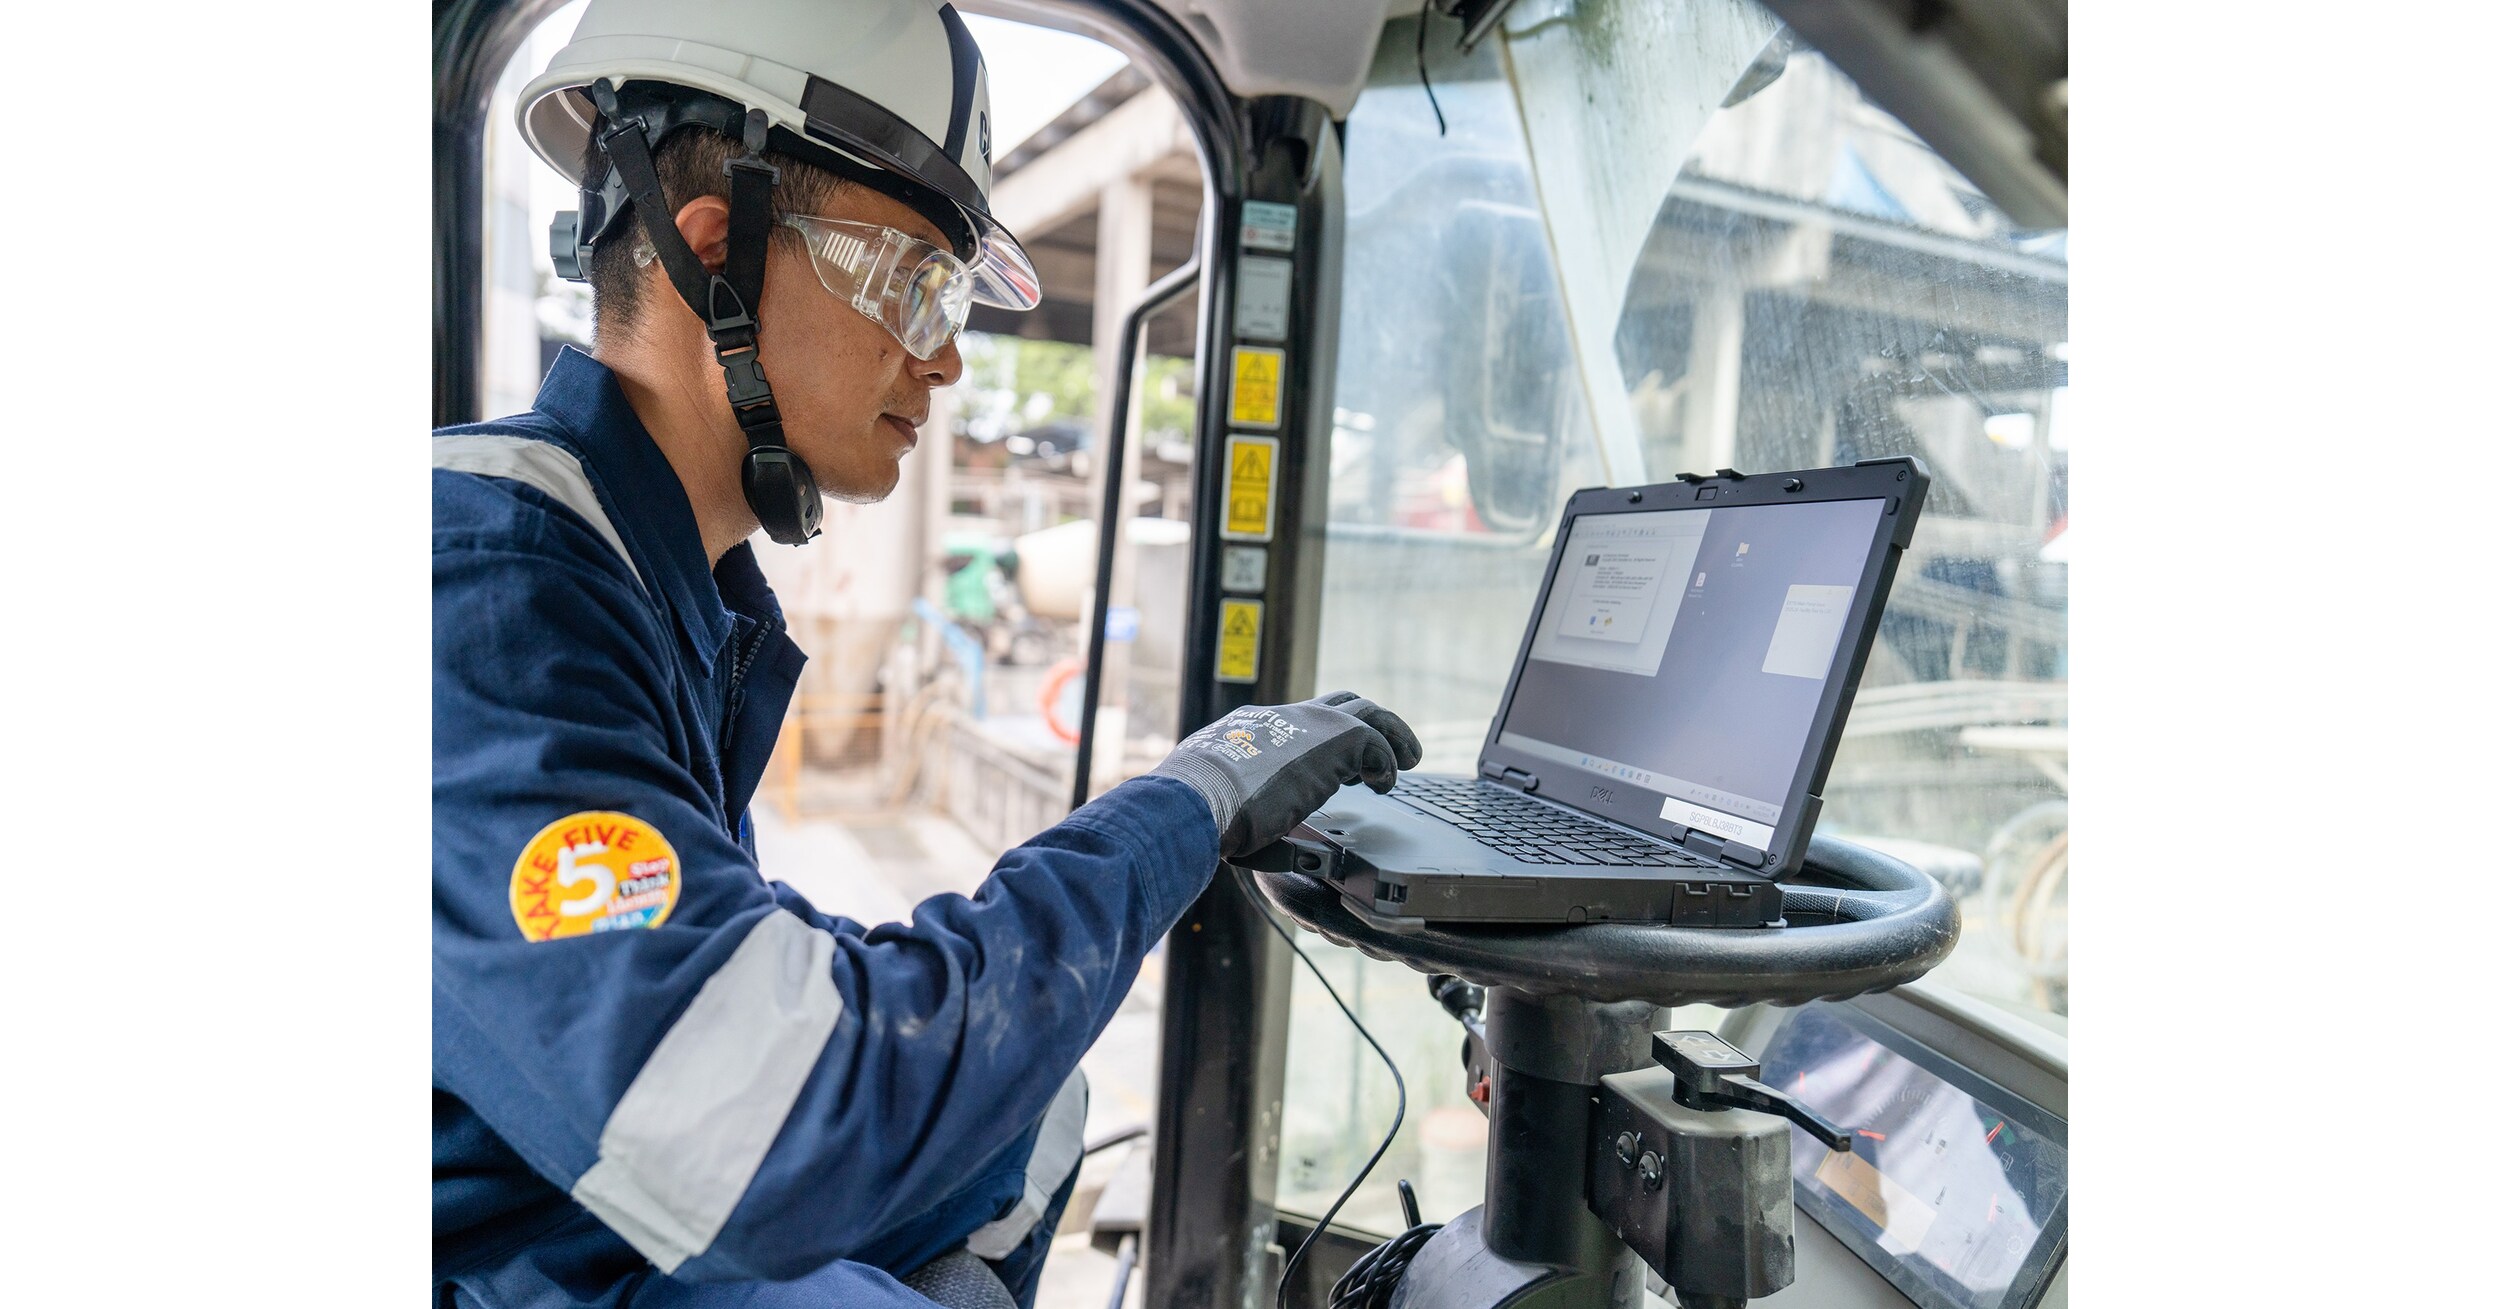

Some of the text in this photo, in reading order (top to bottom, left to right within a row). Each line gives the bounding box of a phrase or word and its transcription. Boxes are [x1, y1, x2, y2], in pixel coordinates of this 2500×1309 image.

[1590, 785, 1613, 804] DELL
[562, 823, 640, 852] FIVE
[556, 839, 616, 917] 5
